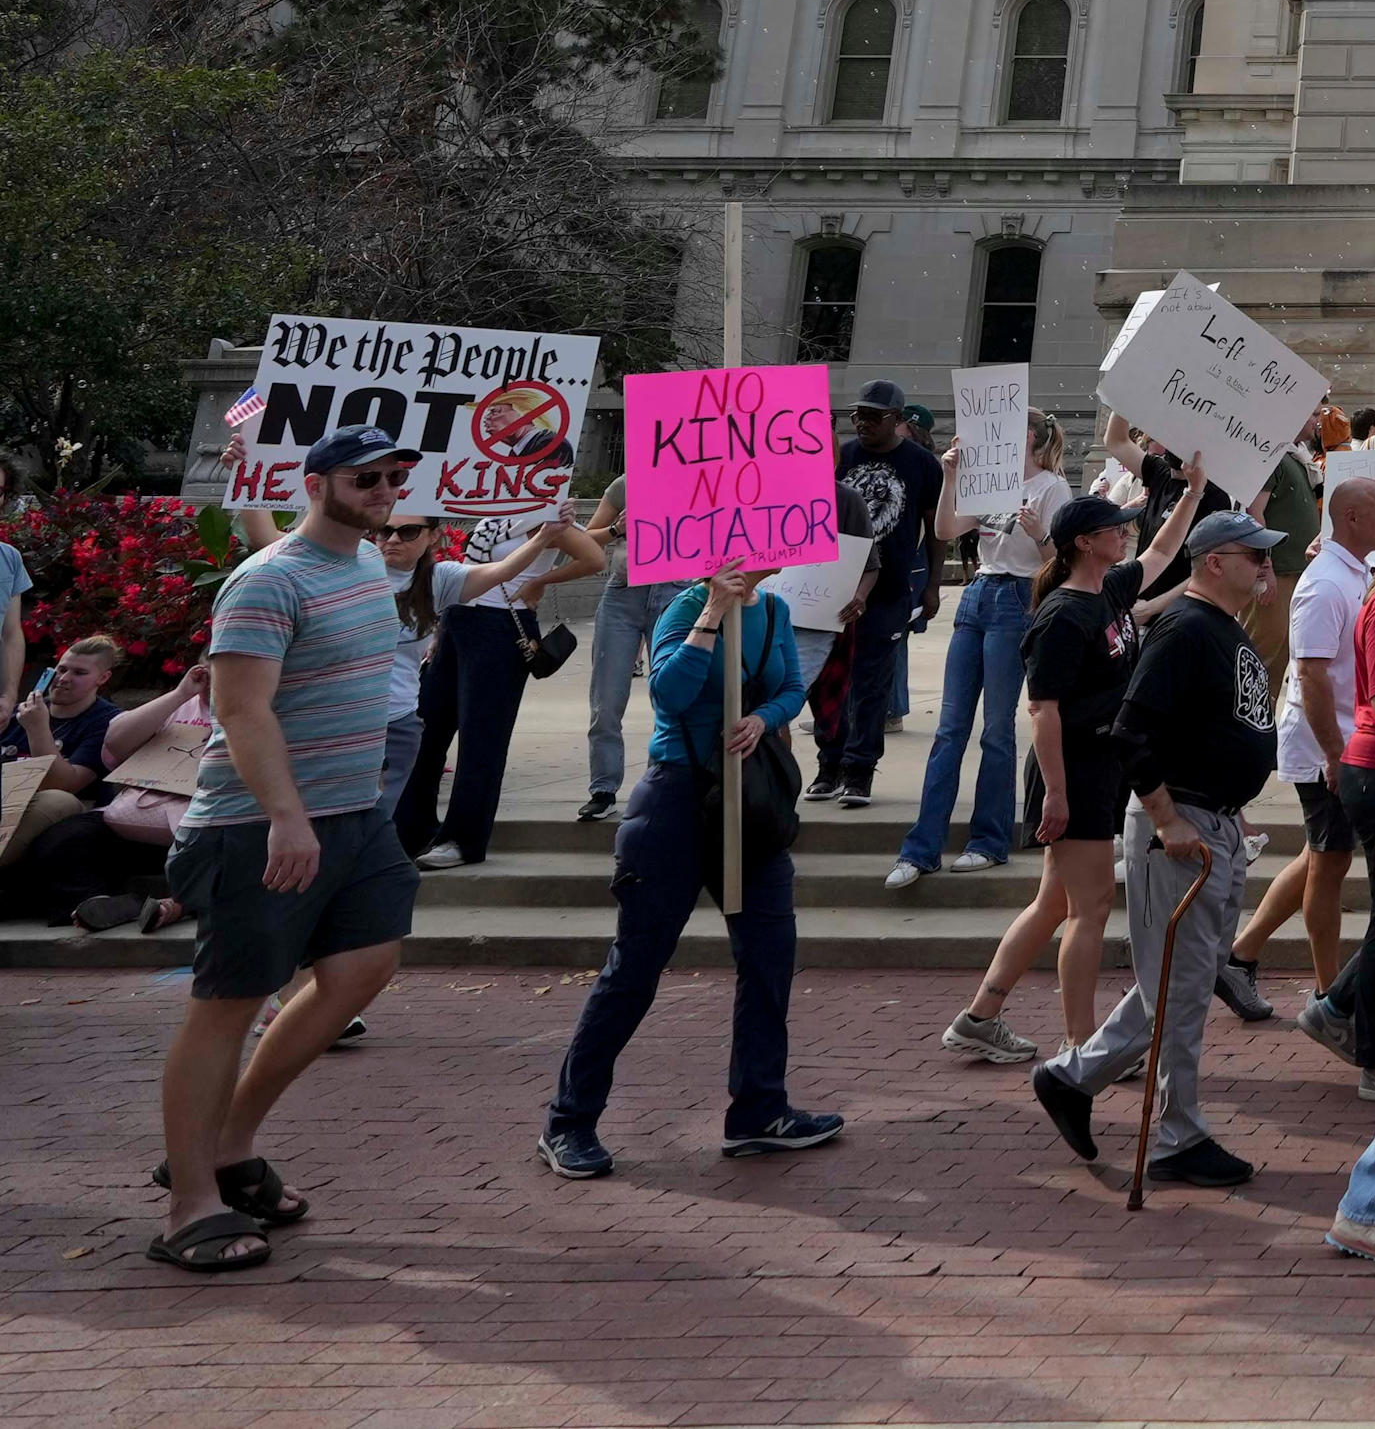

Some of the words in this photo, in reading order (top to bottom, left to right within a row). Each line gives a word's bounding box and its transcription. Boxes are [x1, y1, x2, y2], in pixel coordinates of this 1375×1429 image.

[1160, 301, 1181, 313] not
[1187, 302, 1213, 312] about
[1169, 287, 1202, 300] It's
[272, 321, 348, 369] We
[353, 326, 414, 381] the
[1200, 315, 1246, 361] Left
[1261, 360, 1297, 394] Right
[257, 382, 476, 453] NOT
[695, 372, 764, 419] NO
[961, 383, 1020, 417] SWEAR
[653, 408, 824, 467] KINGS
[984, 421, 1002, 442] IN
[959, 443, 1018, 470] ADELITA
[435, 458, 570, 501] KING
[690, 461, 762, 510] NO
[959, 472, 1020, 498] GRIJALVA
[635, 499, 836, 566] DICTATOR
